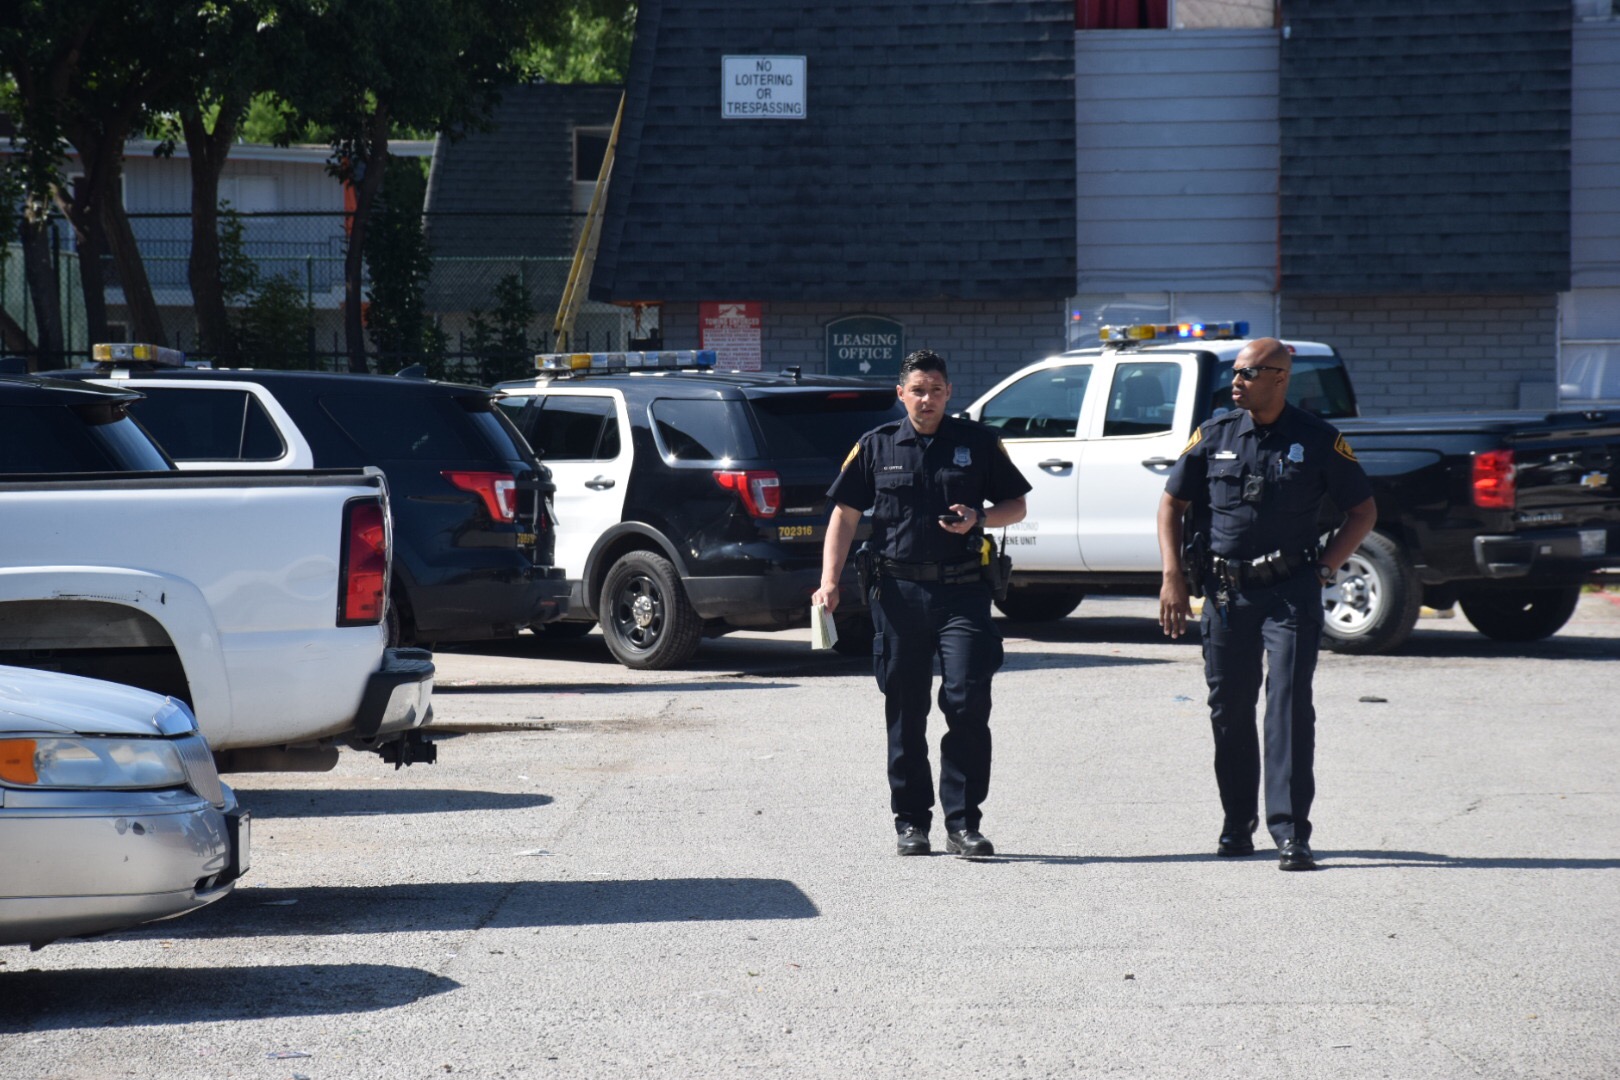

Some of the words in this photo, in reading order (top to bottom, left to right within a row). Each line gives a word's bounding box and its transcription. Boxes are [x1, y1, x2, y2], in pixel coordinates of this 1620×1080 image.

[756, 60, 772, 72] NO
[735, 74, 793, 86] LOITERING
[756, 88, 772, 100] OR
[727, 102, 802, 114] TRESPASSING
[833, 333, 898, 346] LEASING
[838, 347, 893, 360] OFFICE
[778, 525, 813, 537] 702316
[997, 536, 1018, 546] SENE
[1020, 536, 1037, 546] UNIT
